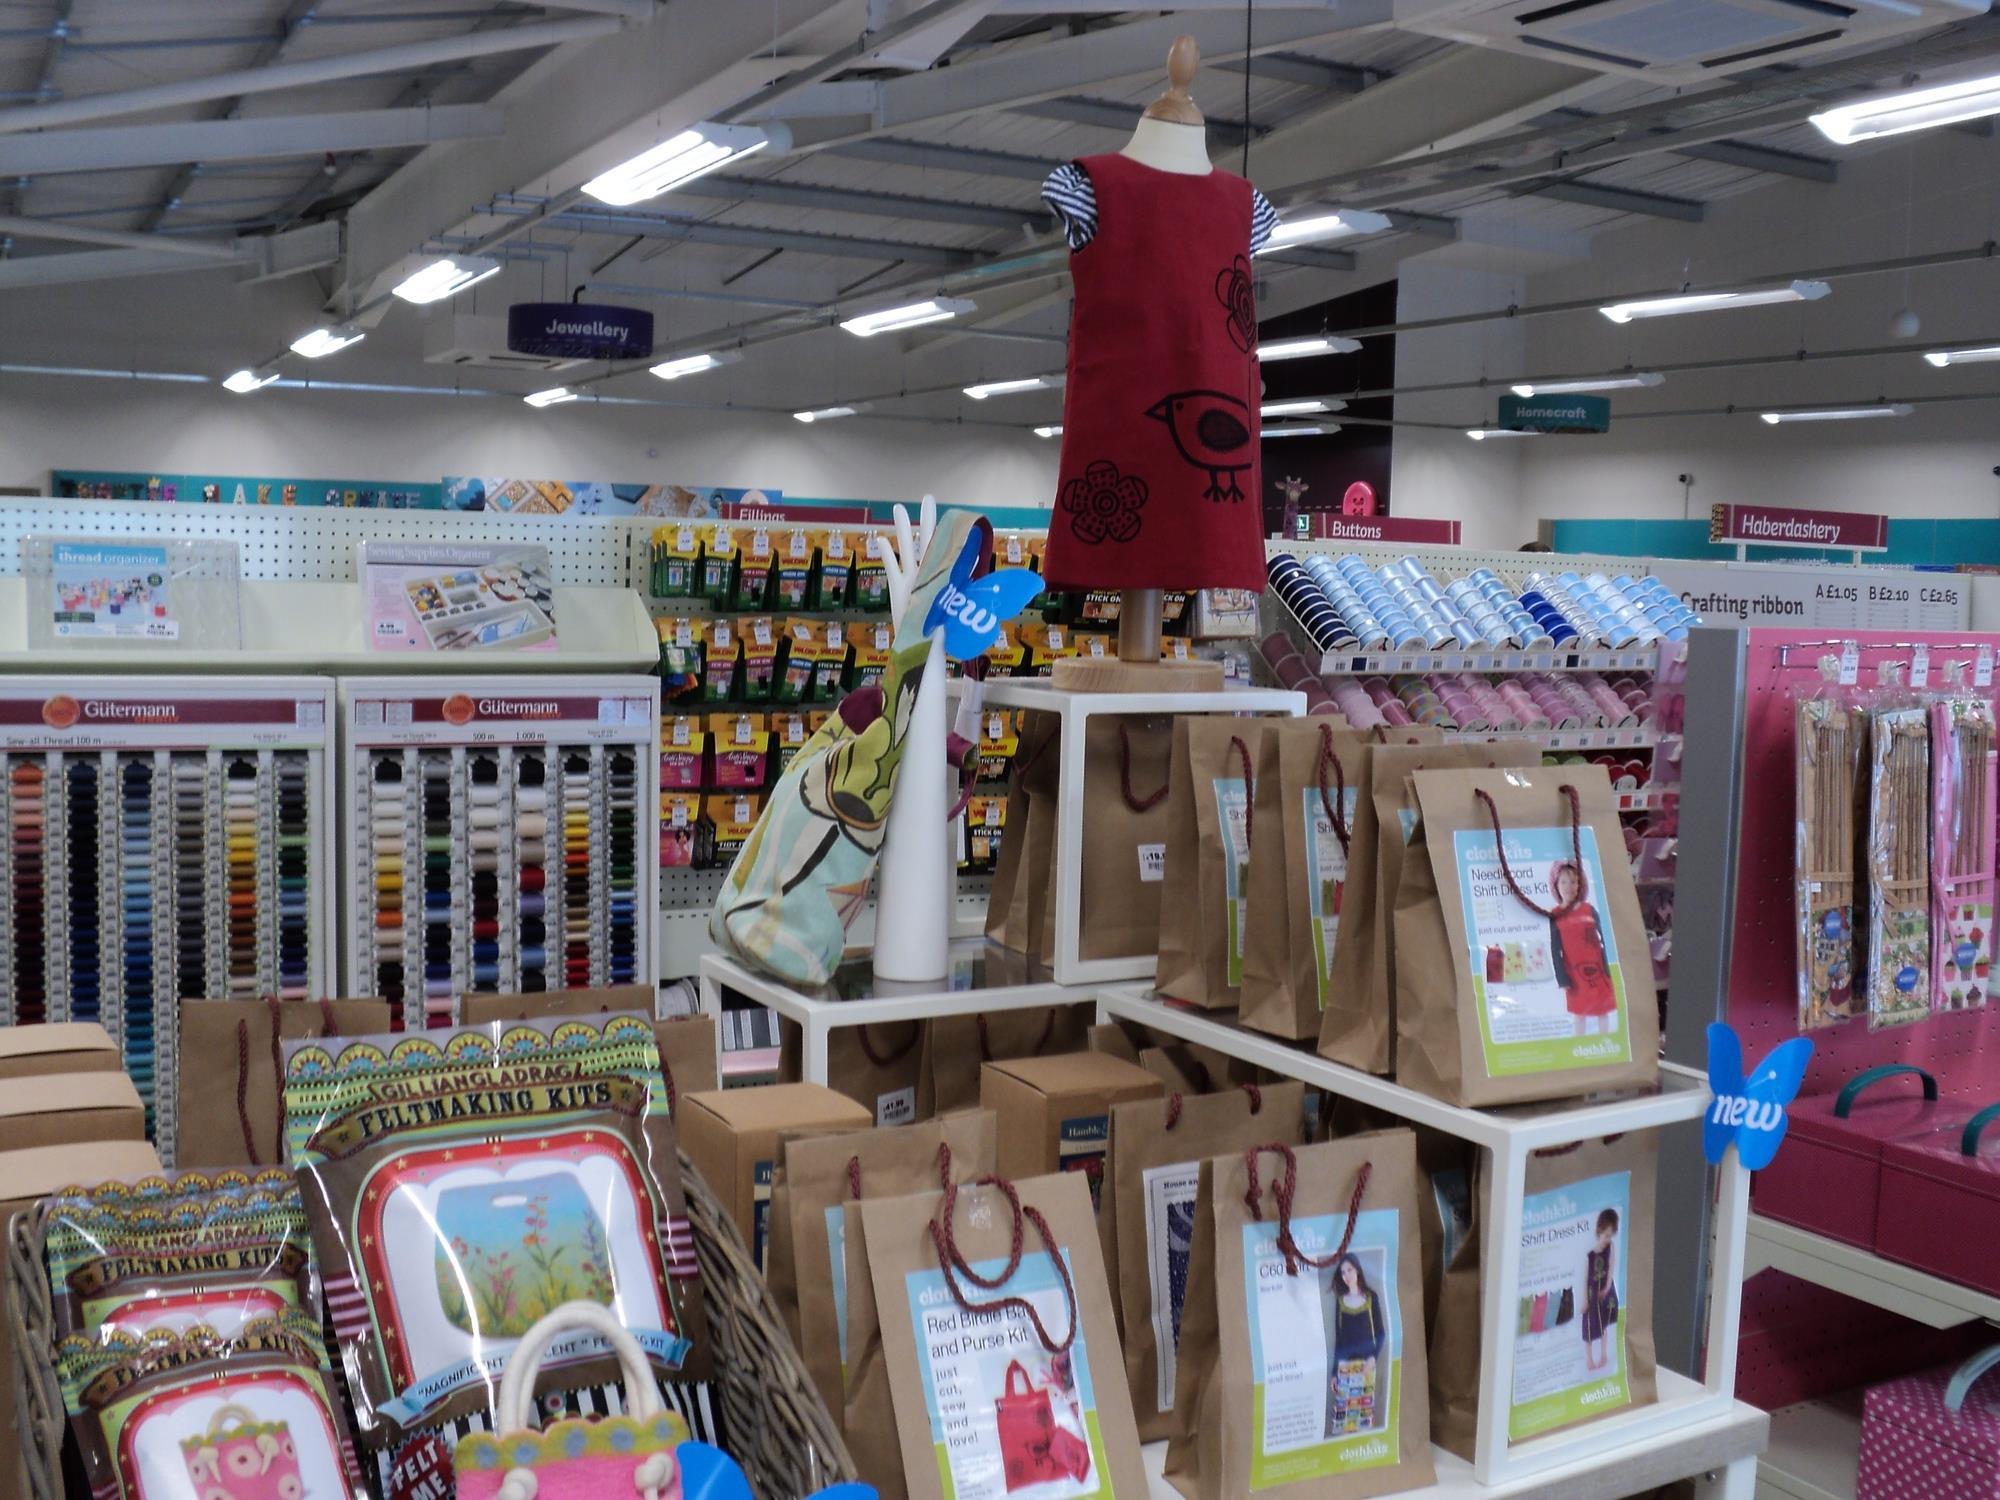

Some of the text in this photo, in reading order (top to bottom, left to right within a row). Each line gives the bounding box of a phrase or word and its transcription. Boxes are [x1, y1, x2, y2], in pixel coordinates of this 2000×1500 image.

[545, 319, 629, 342] Jewellery
[1516, 407, 1587, 419] Homecraft
[739, 508, 786, 521] Fillings
[1332, 521, 1382, 539] Buttons
[1742, 514, 1841, 544] Haberdashery
[58, 551, 159, 565] thread organizer
[1815, 584, 1858, 601] A £1.05
[1869, 586, 1909, 601] B £2.10
[1920, 588, 1958, 605] C £2.65
[938, 584, 997, 633] new
[1680, 592, 1748, 619] Crafting
[1752, 596, 1804, 615] ribbon
[84, 700, 176, 718] Gütermann
[478, 699, 559, 715] Gütermann
[43, 736, 74, 746] Thread
[76, 736, 92, 746] 100
[1465, 845, 1532, 861] clotkits
[1472, 867, 1534, 881] Needlcord
[1474, 883, 1549, 898] Shift Drss Kit
[357, 1082, 612, 1138] FELTMAKING KITS
[1713, 1095, 1782, 1131] new
[1521, 1220, 1591, 1247] Shift Dress Kit
[1259, 1263, 1284, 1279] C60
[927, 1316, 957, 1334] Red
[960, 1310, 1002, 1327] Birdie
[651, 1335, 664, 1350] KIT
[932, 1327, 1029, 1359] and Purse Kit
[935, 1366, 958, 1382] just
[1268, 1361, 1283, 1373] just
[939, 1386, 962, 1397] cut,
[942, 1401, 966, 1413] sew
[946, 1416, 969, 1430] and
[949, 1433, 978, 1448] love!
[393, 1440, 438, 1491] FELT
[411, 1472, 447, 1500] ME
